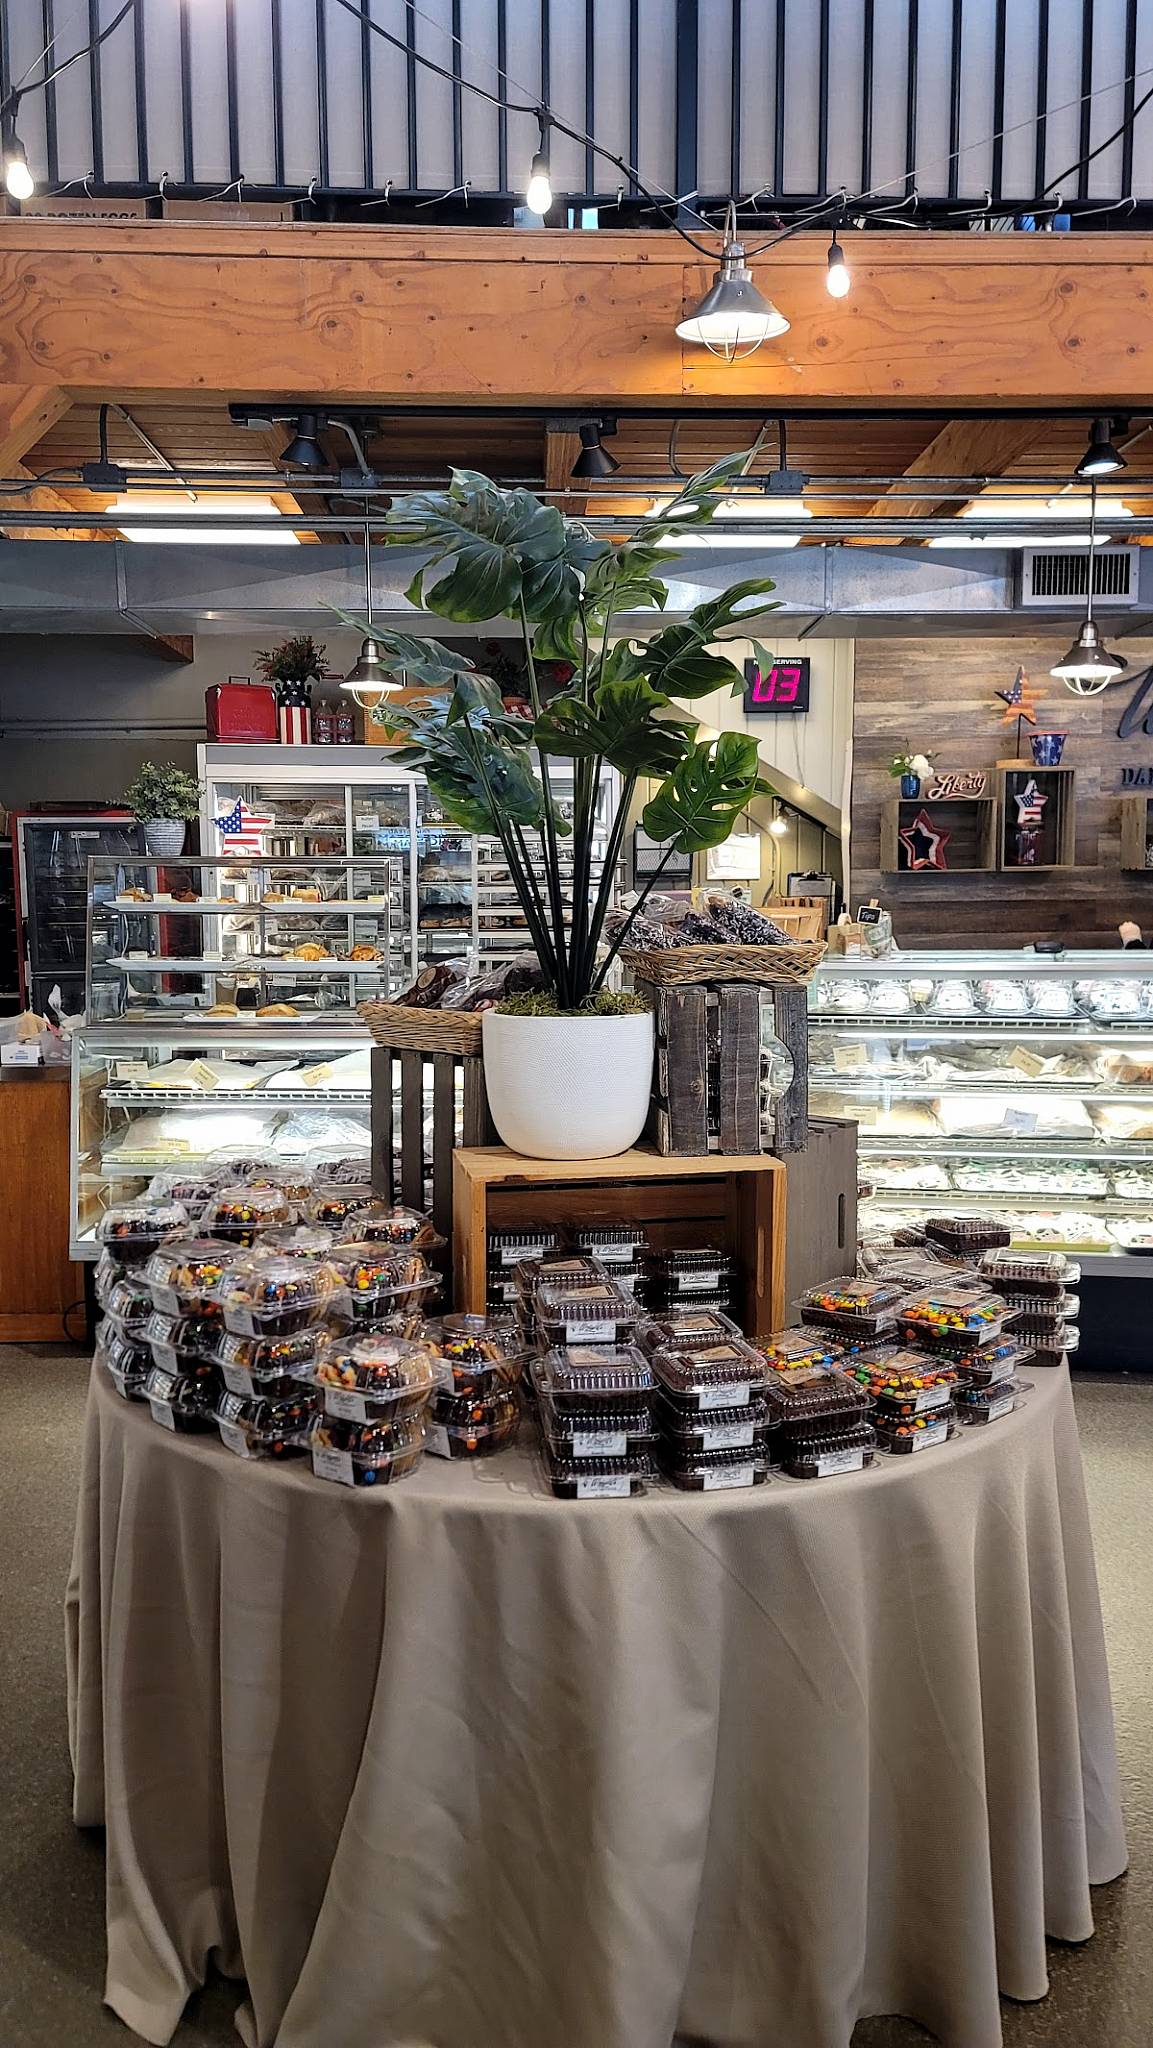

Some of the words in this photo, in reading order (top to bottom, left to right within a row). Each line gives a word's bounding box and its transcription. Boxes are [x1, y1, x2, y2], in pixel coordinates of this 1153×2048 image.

[752, 668, 800, 701] 03
[928, 771, 987, 799] Liberty
[861, 911, 876, 921] Tips
